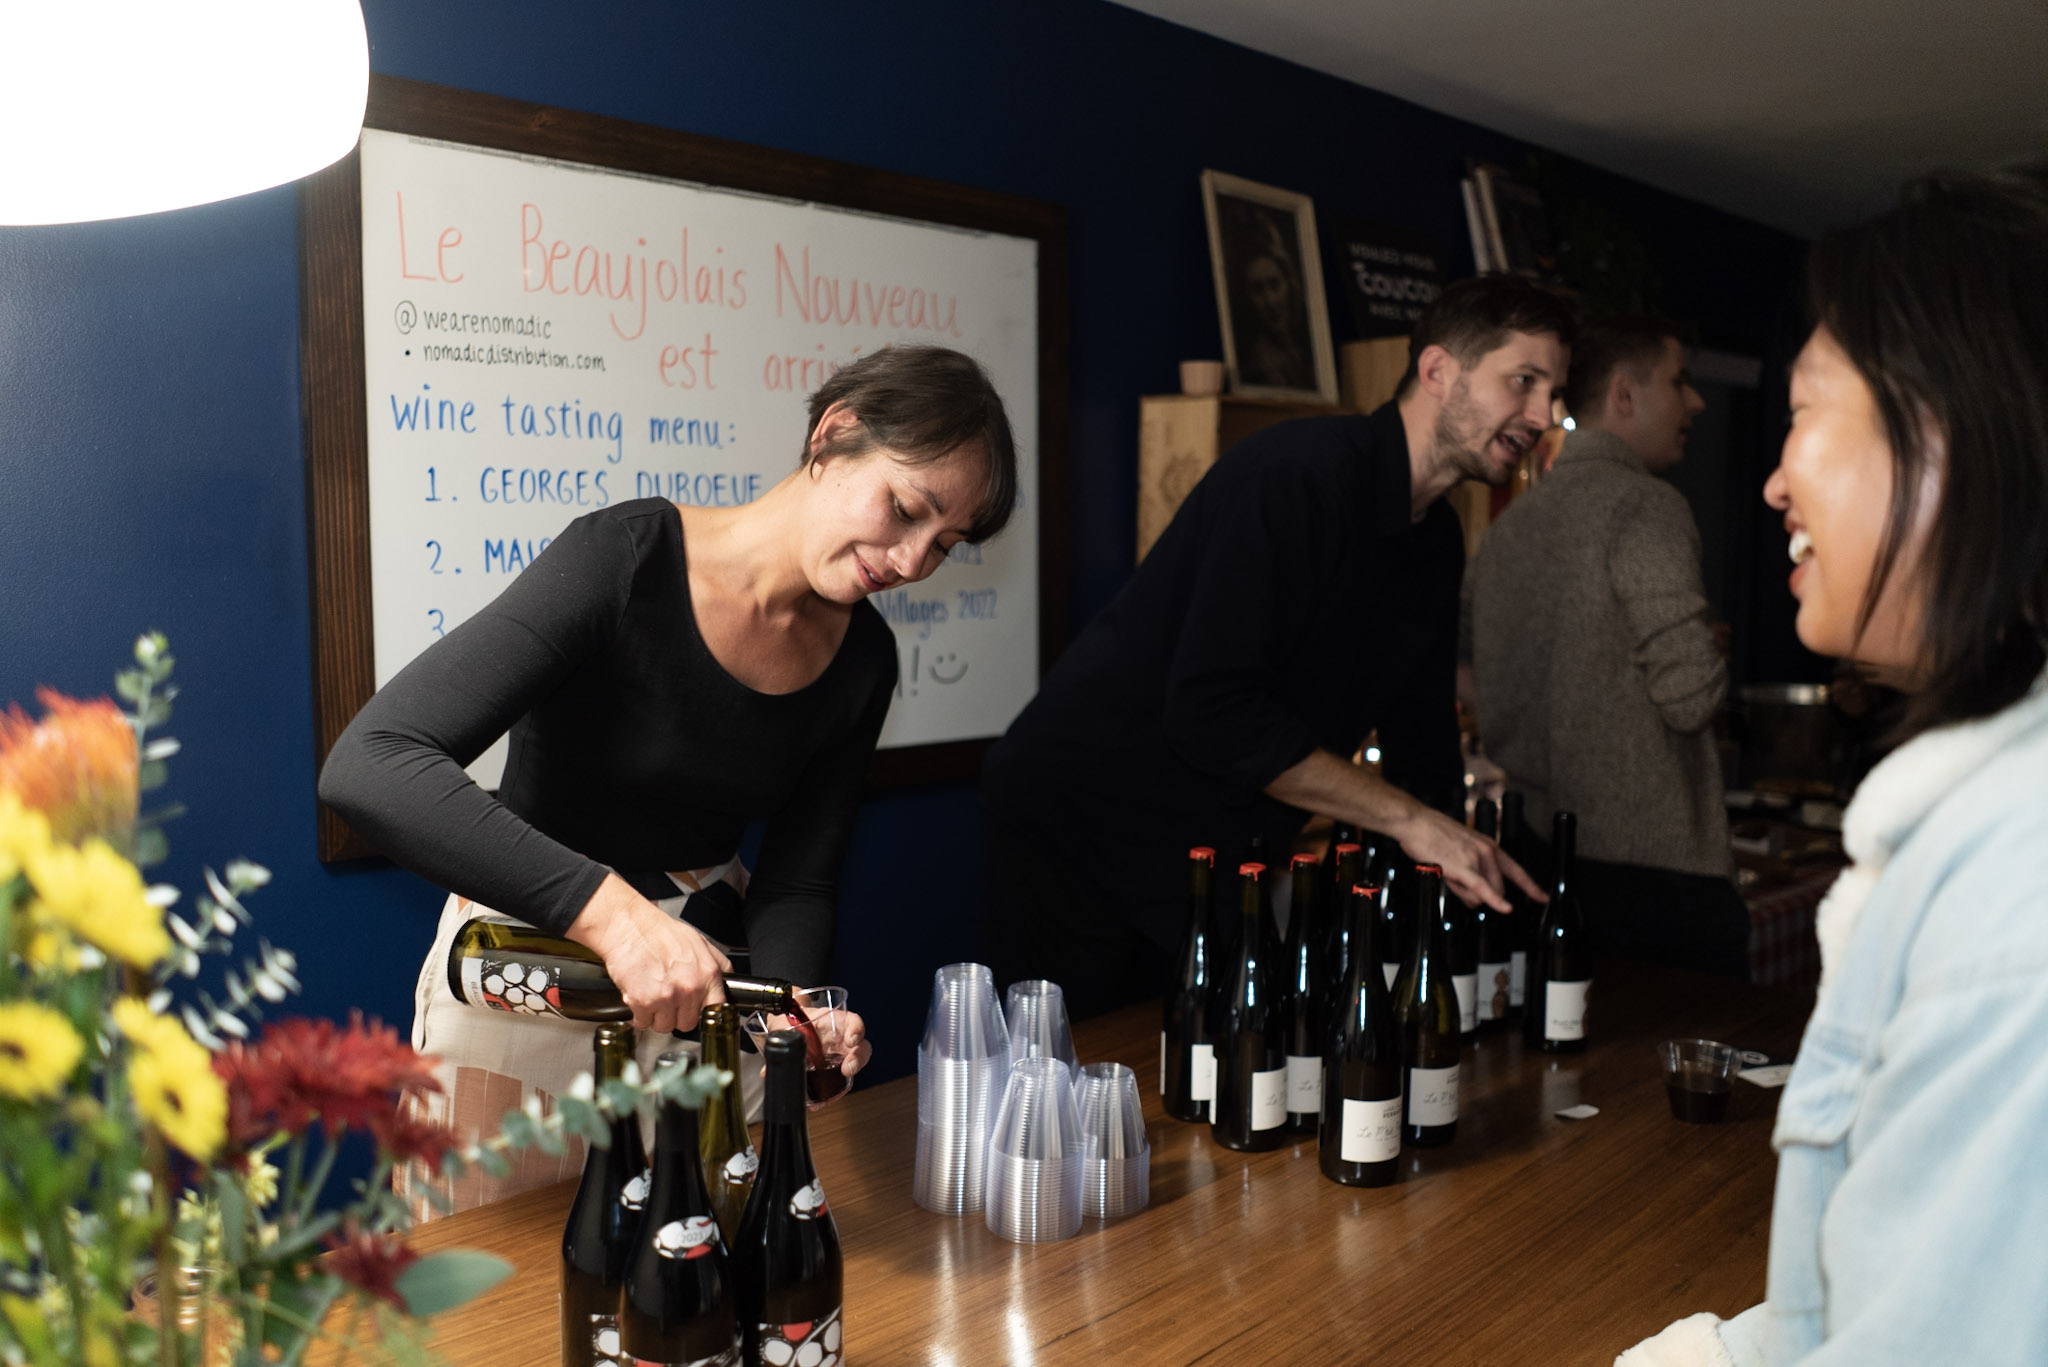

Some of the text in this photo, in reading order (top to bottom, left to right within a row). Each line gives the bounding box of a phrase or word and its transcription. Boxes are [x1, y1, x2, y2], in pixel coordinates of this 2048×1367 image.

[396, 190, 963, 341] Le Beaujolais Nouveau
[395, 300, 552, 340] @ wearenomadic
[658, 333, 719, 391] est
[501, 395, 624, 463] tasting
[649, 409, 737, 449] menu:
[425, 467, 458, 502] 1.
[480, 467, 610, 508] GEORGES
[426, 540, 462, 575] 2.
[875, 588, 949, 641] Villages
